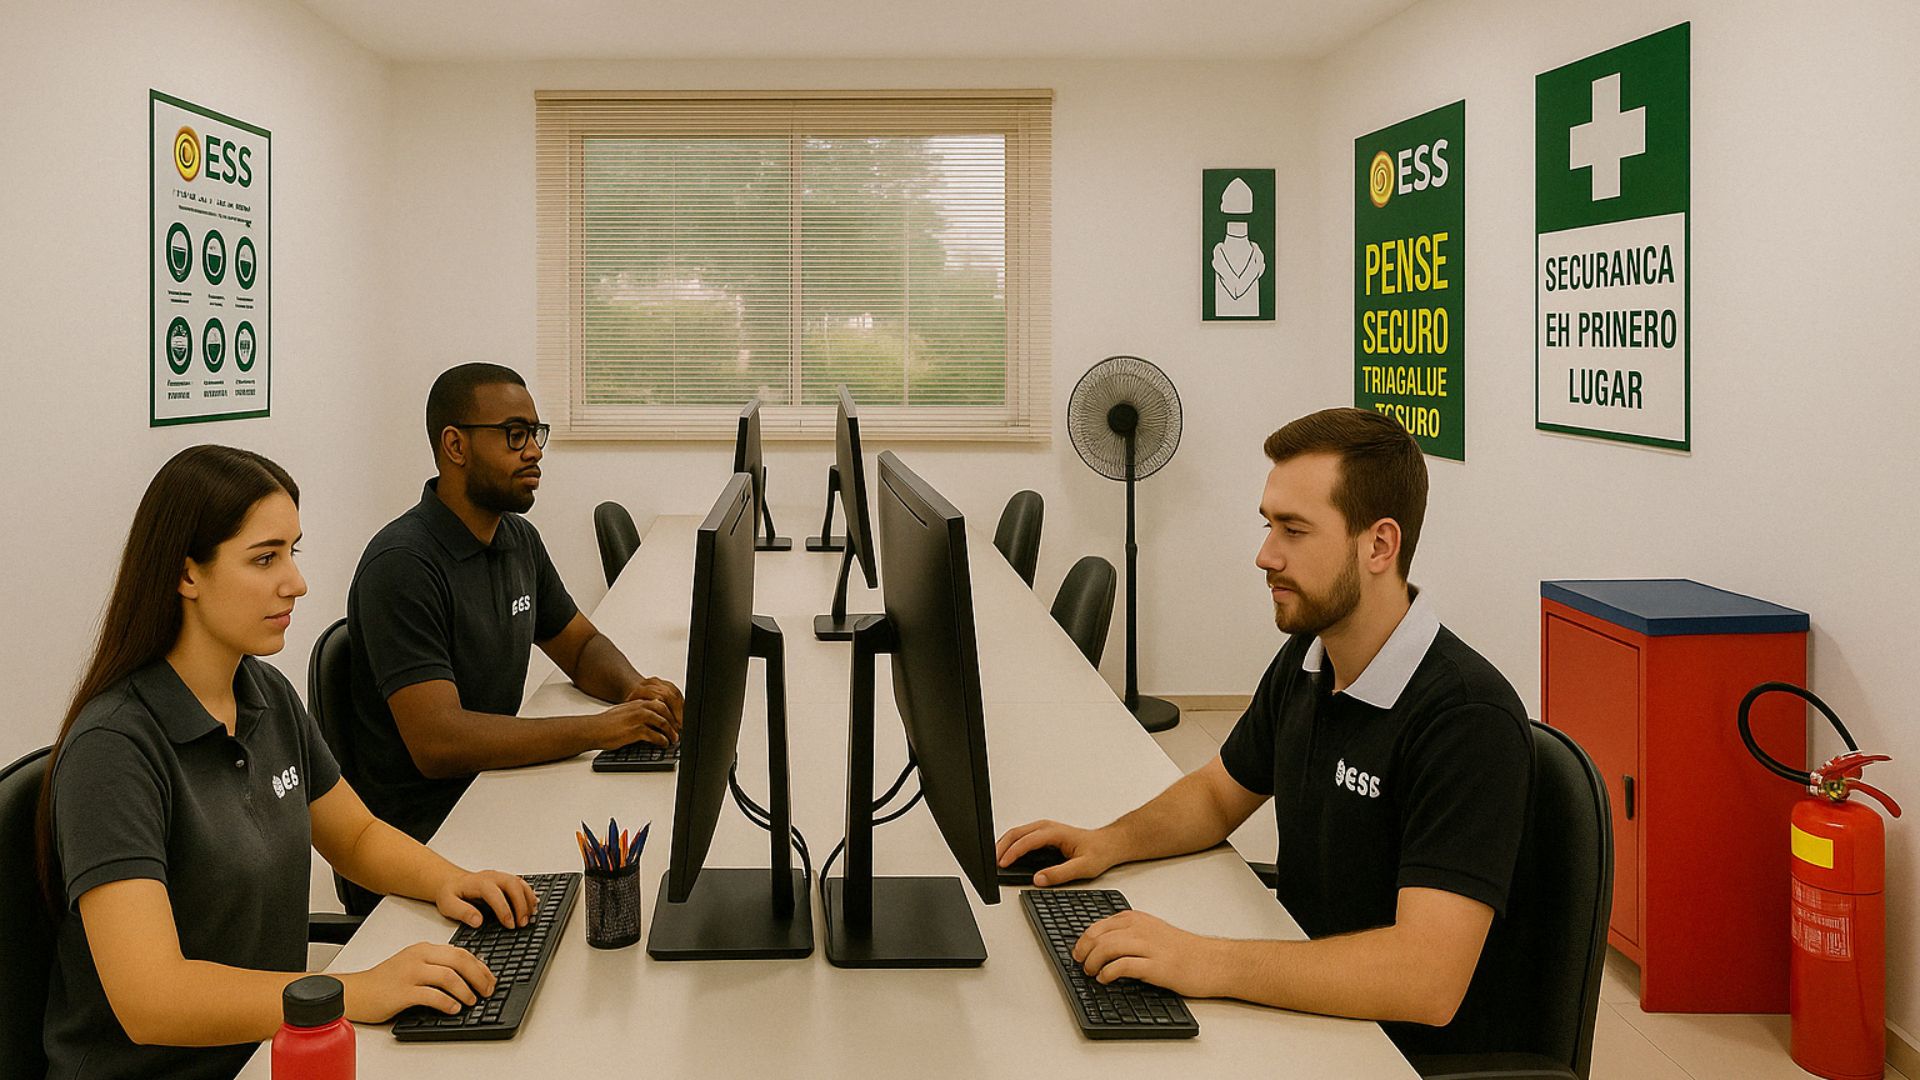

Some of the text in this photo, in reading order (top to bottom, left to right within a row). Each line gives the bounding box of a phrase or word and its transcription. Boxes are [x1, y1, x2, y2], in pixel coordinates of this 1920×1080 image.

[206, 135, 252, 188] ESS
[1398, 139, 1449, 195] ESS
[1365, 232, 1449, 296] PENSE
[1545, 244, 1675, 292] SECURANCA
[1363, 307, 1449, 355] SECURO
[1546, 309, 1677, 349] EH PRINERO
[1362, 366, 1448, 397] TRIAGALUE
[1569, 368, 1643, 410] LUGAR
